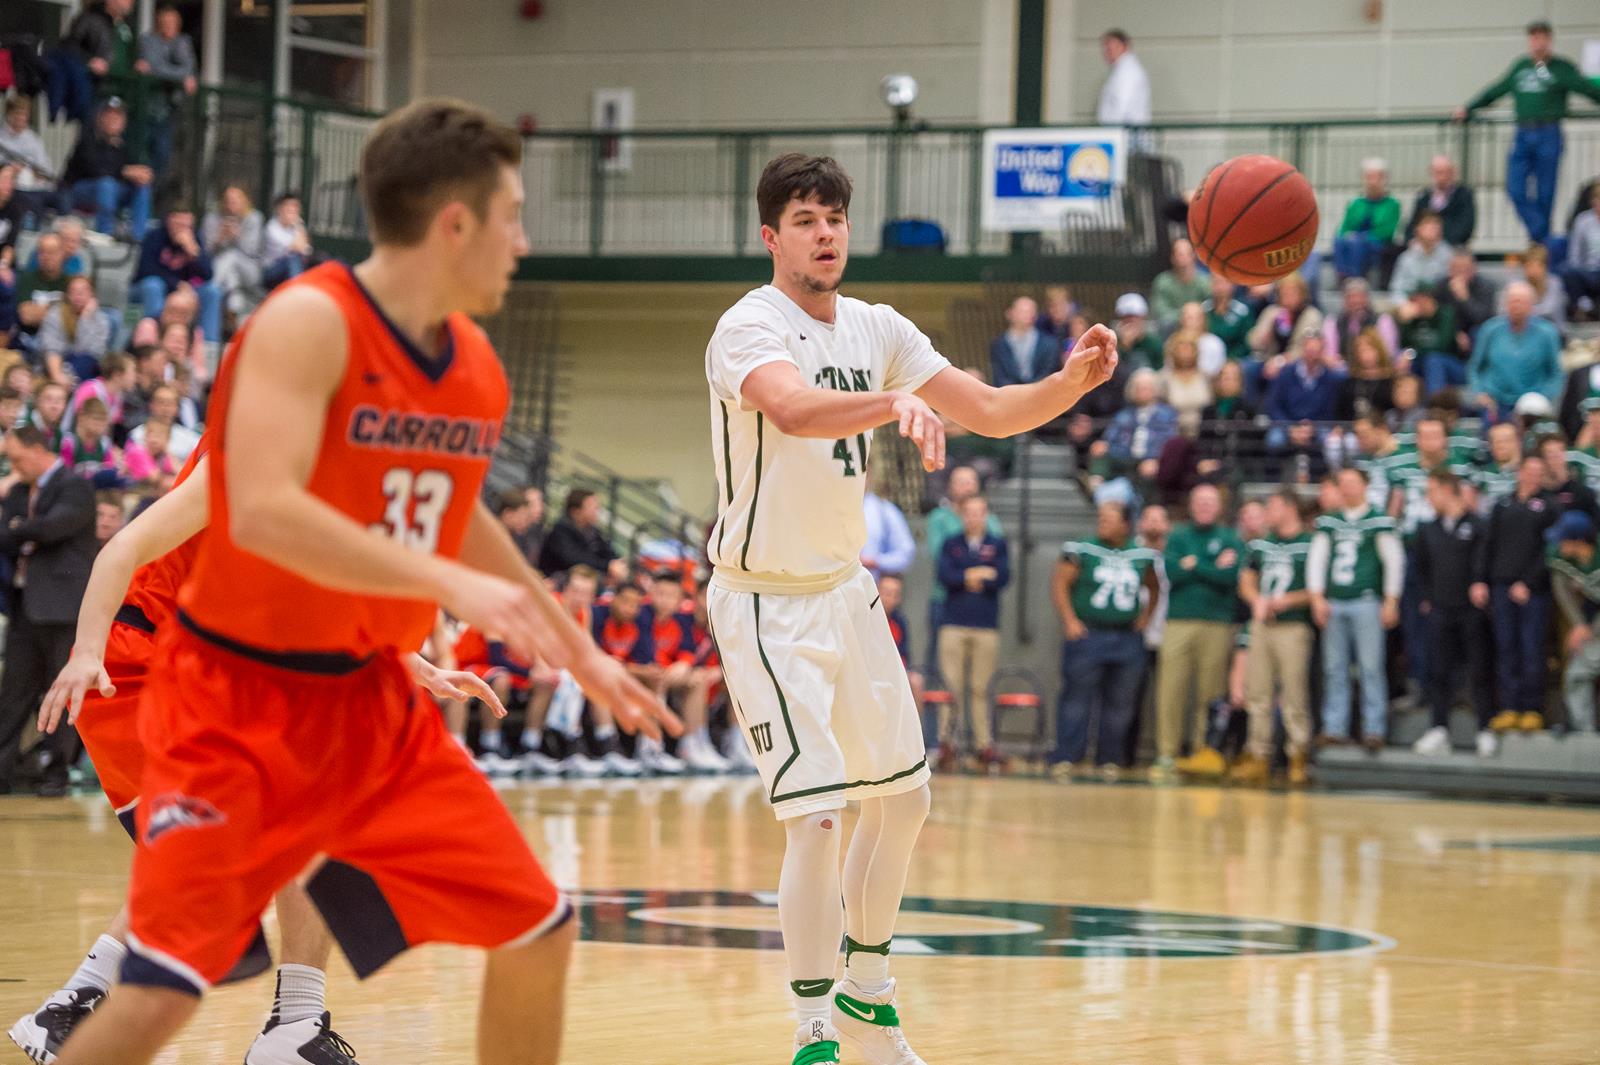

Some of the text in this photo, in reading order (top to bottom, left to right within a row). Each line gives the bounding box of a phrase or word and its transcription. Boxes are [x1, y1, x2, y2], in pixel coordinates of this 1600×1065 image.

[998, 146, 1063, 172] United
[1020, 170, 1062, 195] Way
[346, 403, 500, 460] CARROLL
[832, 432, 867, 476] 41
[368, 467, 454, 556] 33
[1331, 540, 1358, 586] 2
[1091, 565, 1140, 611] 70
[748, 721, 773, 755] WU
